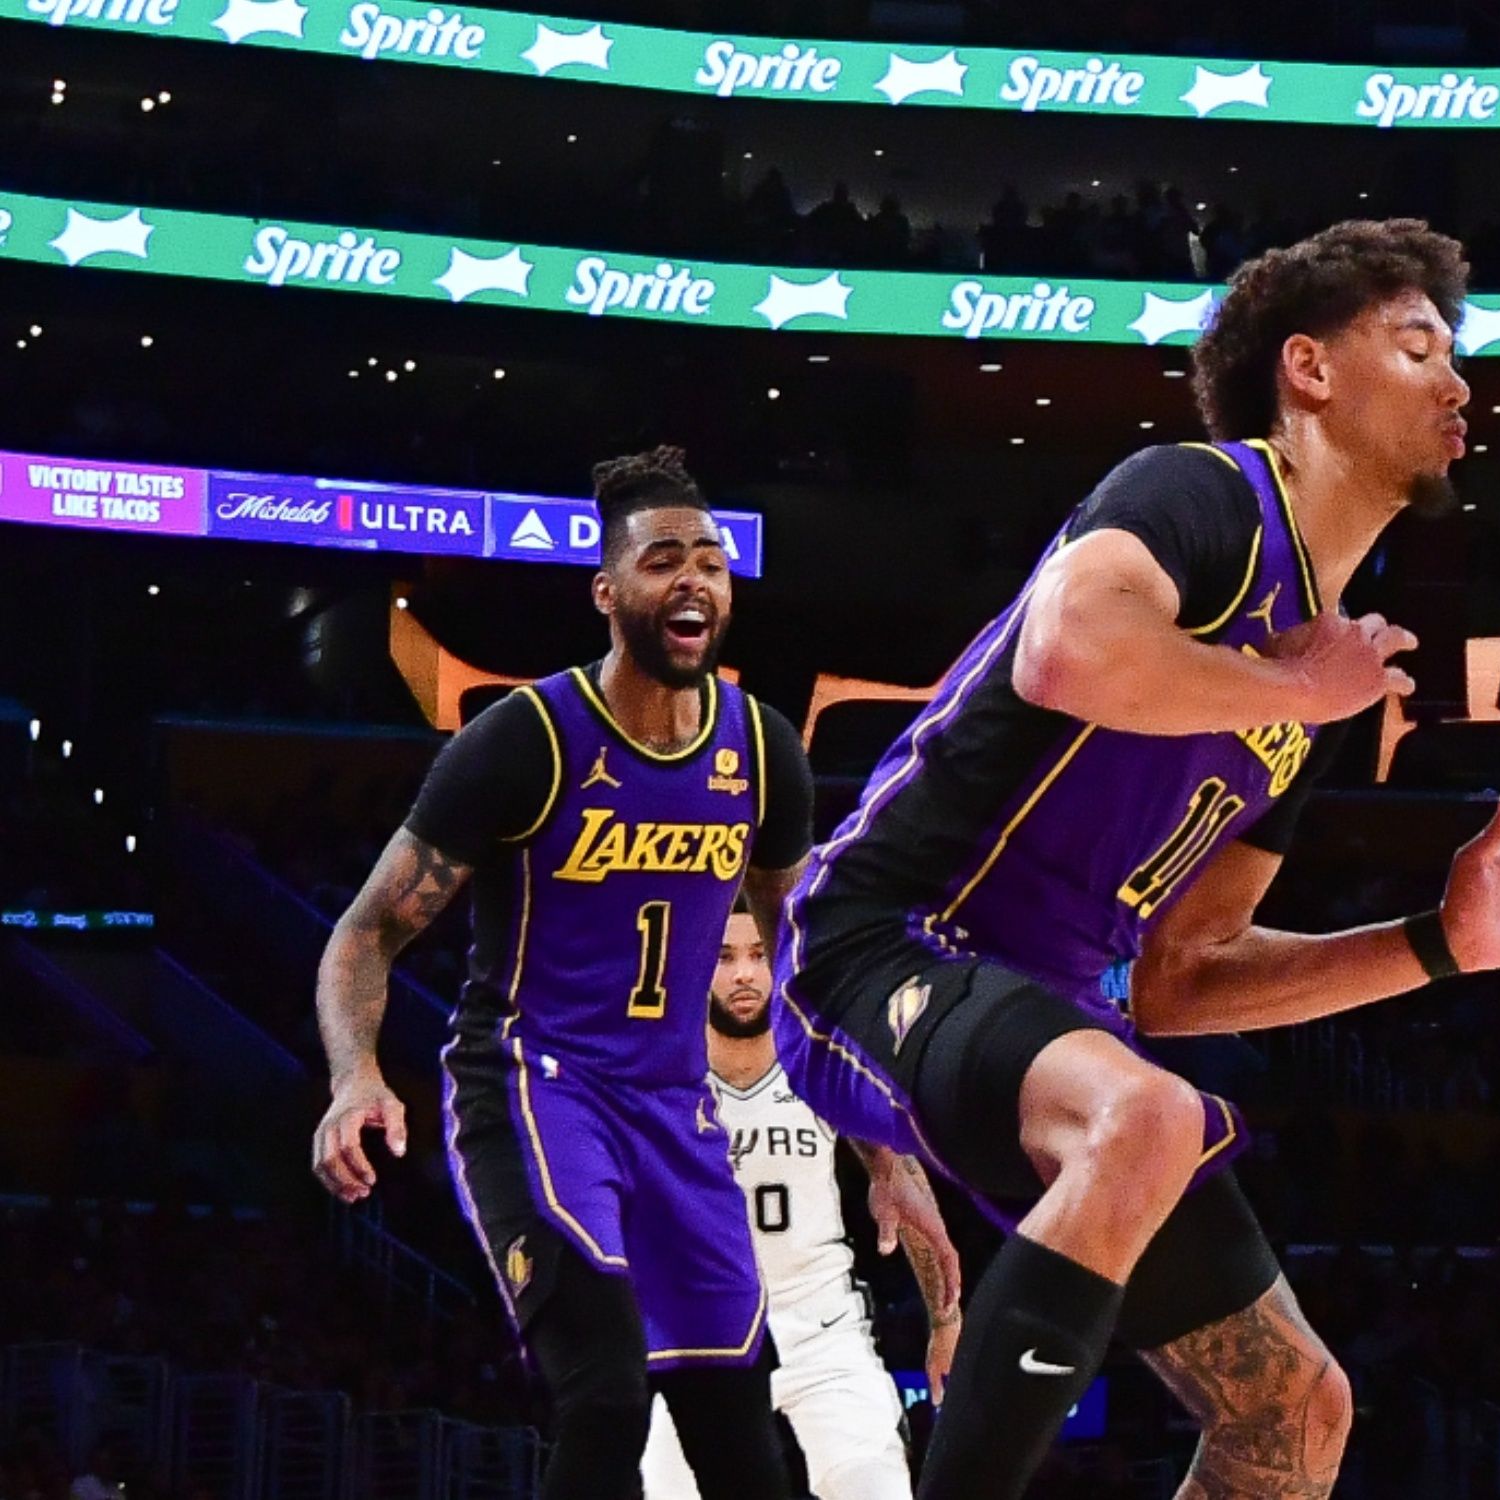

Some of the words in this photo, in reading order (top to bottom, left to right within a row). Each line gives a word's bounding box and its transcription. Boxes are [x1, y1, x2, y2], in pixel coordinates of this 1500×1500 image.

[339, 2, 486, 59] Sprite
[695, 41, 842, 97] Sprite
[1000, 56, 1145, 112] Sprite
[1356, 73, 1500, 127] Sprite
[244, 226, 400, 286] Sprite
[565, 257, 715, 315] Sprite
[942, 281, 1094, 338] Sprite
[28, 464, 112, 494] VICTORY
[115, 472, 184, 499] TASTES
[53, 493, 98, 519] LIKE
[102, 497, 160, 523] TACOS
[216, 493, 332, 525] Michelob
[361, 502, 474, 536] ULTRA
[552, 808, 750, 883] LAKERS
[1116, 777, 1246, 920] 11
[627, 900, 671, 1018] 1
